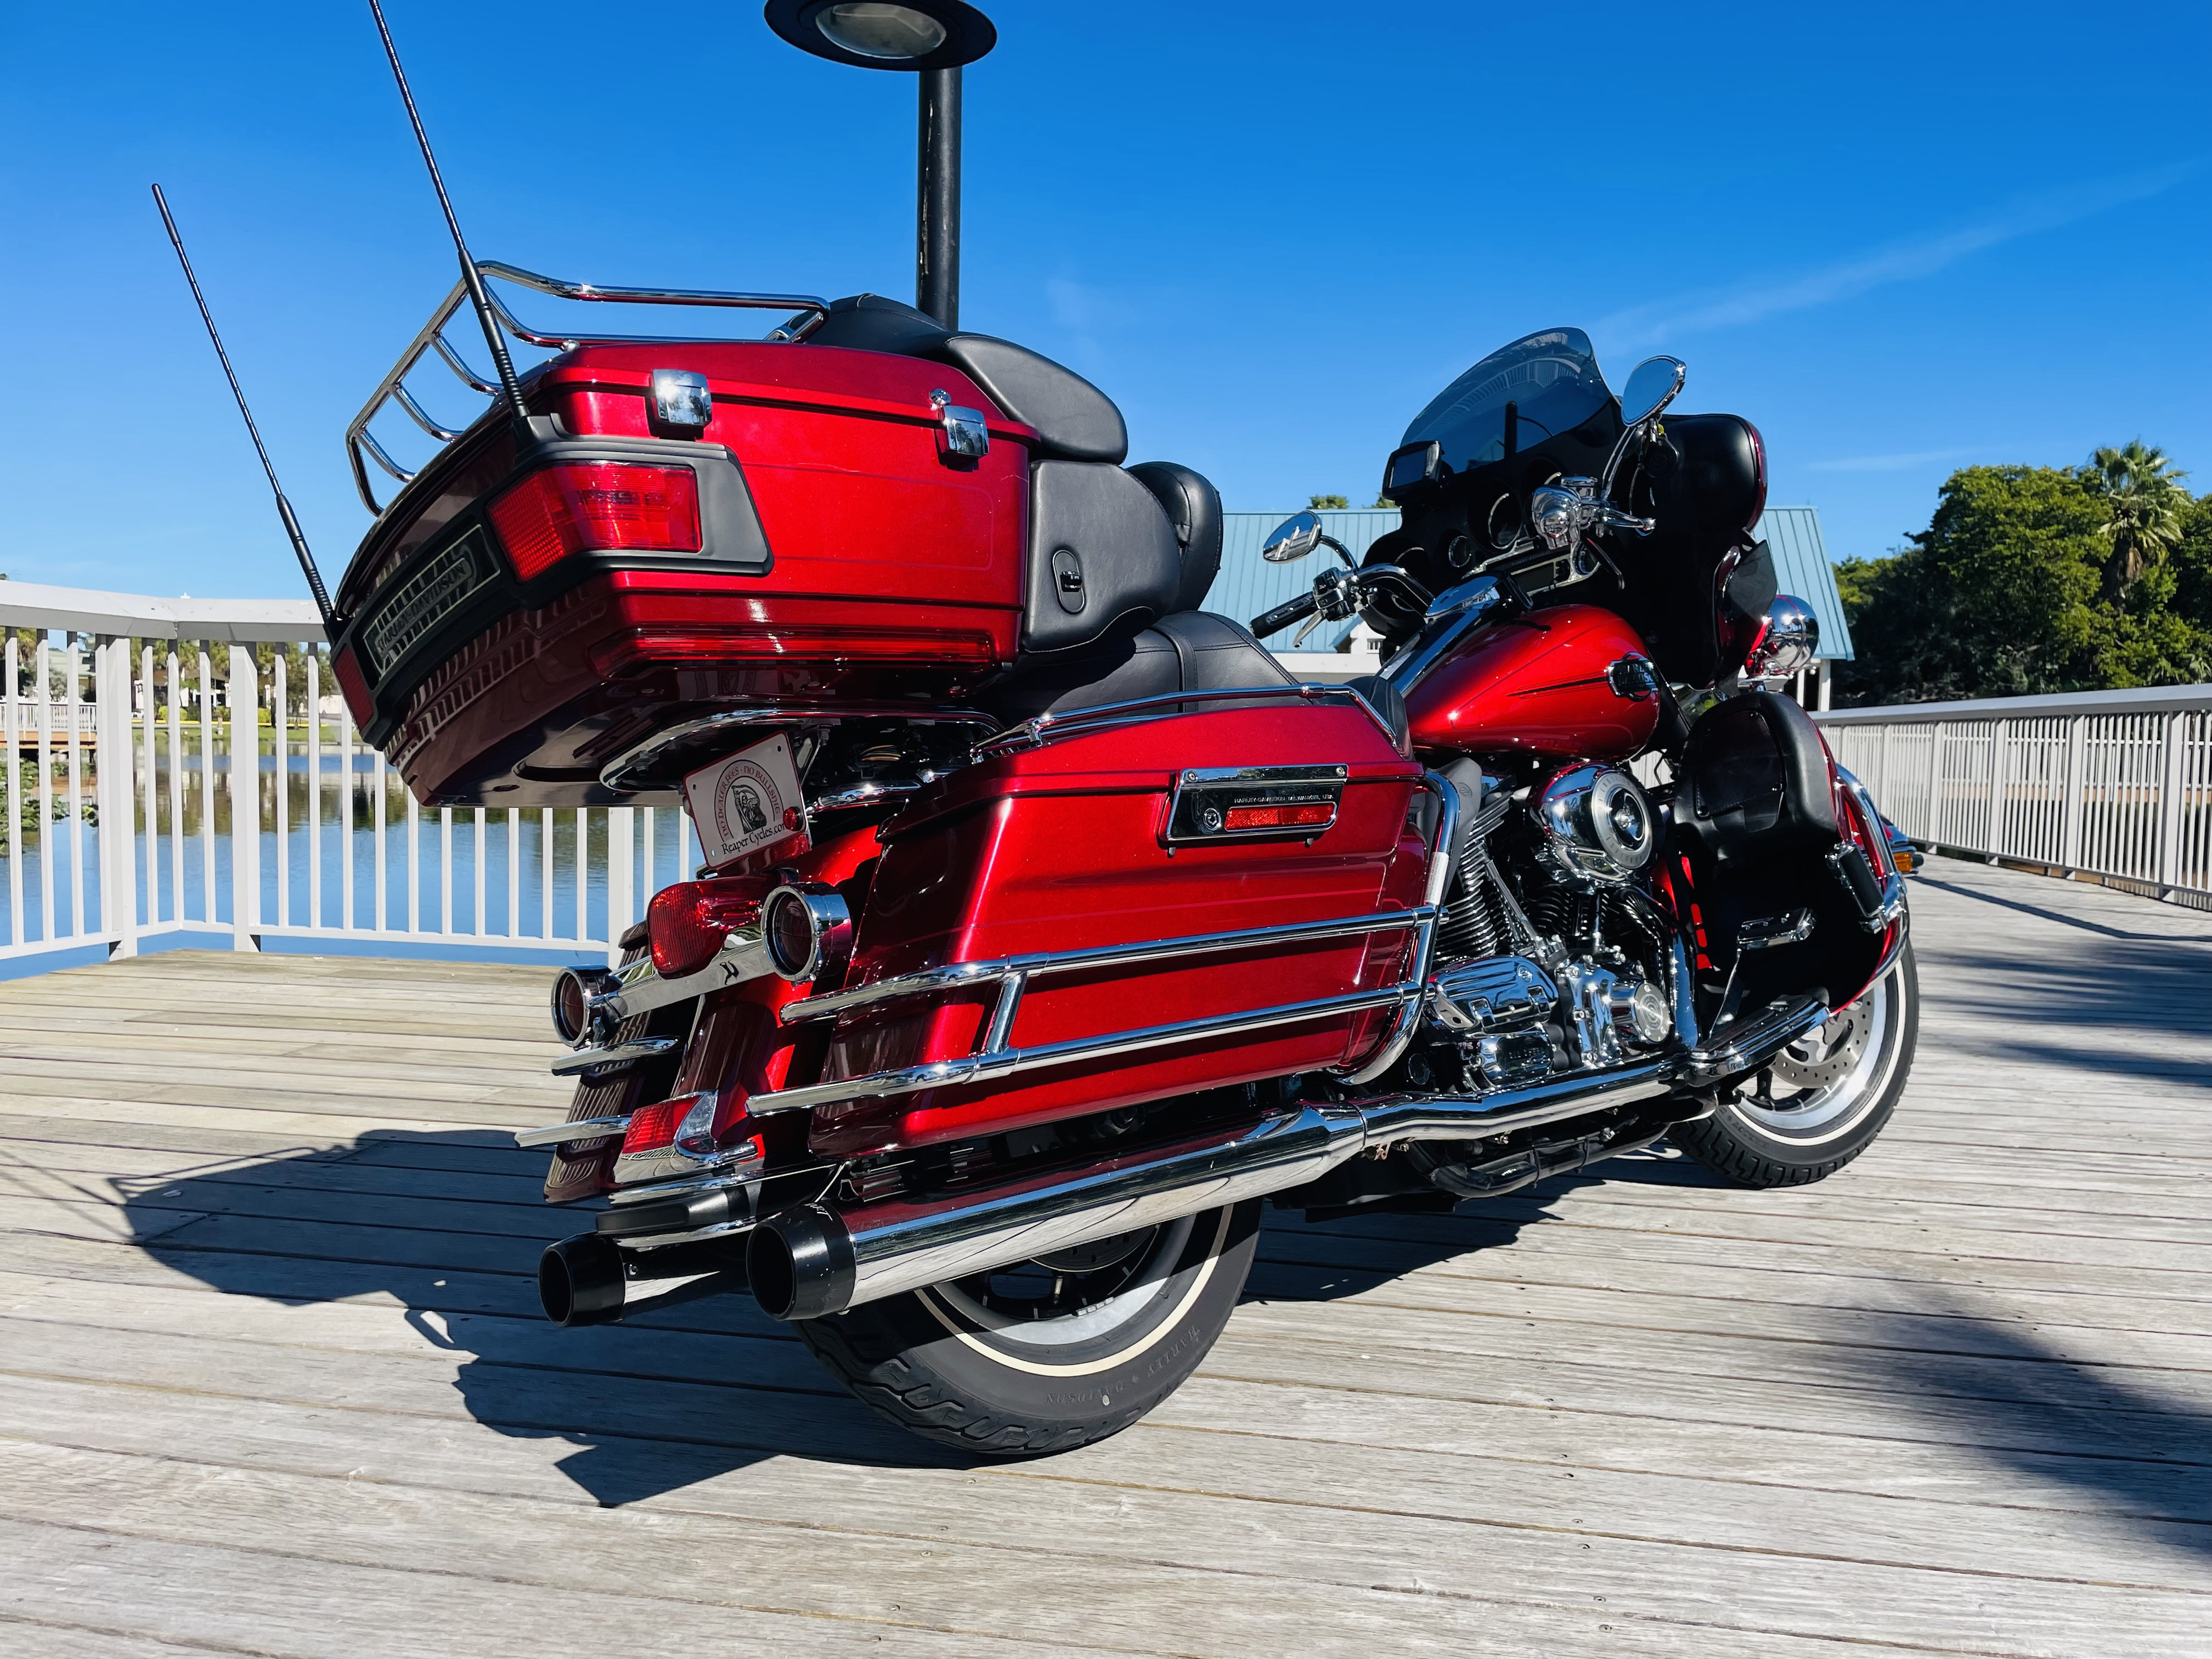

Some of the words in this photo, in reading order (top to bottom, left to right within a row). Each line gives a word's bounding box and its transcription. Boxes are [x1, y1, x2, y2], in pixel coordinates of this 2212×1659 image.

[718, 782, 727, 819] DEALER
[725, 766, 740, 783] FEES
[744, 765, 754, 775] NO
[721, 838, 748, 855] Reaper
